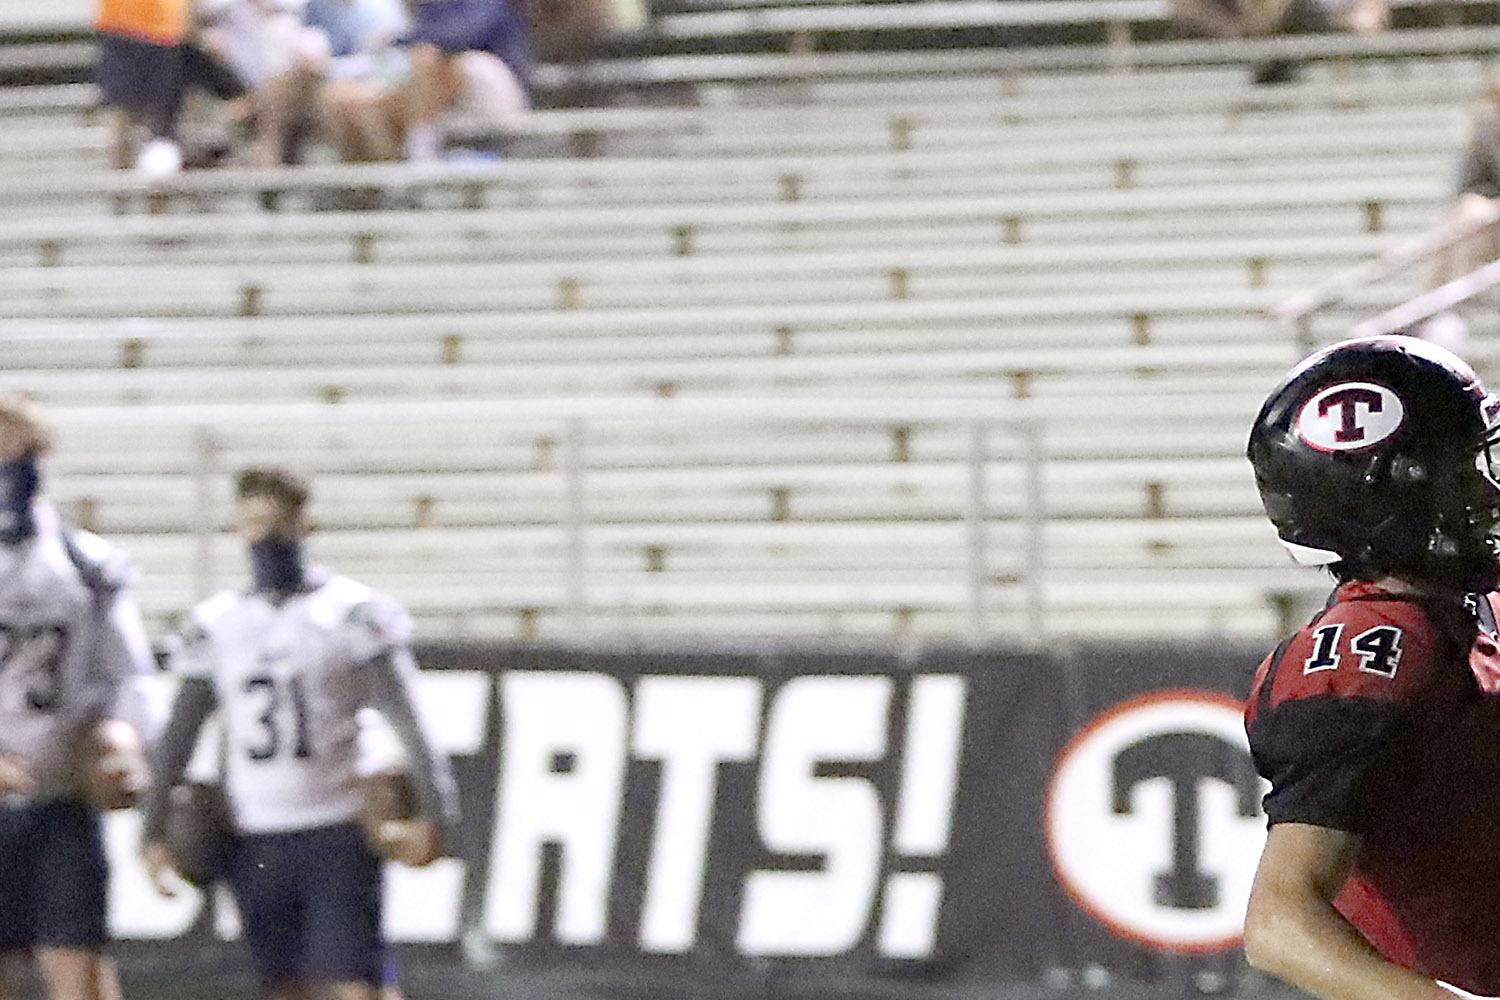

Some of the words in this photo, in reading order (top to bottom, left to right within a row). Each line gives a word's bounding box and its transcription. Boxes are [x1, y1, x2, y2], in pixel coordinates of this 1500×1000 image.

[1319, 389, 1383, 442] T
[1303, 623, 1403, 680] 14
[243, 674, 311, 762] 31
[1111, 730, 1258, 909] T
